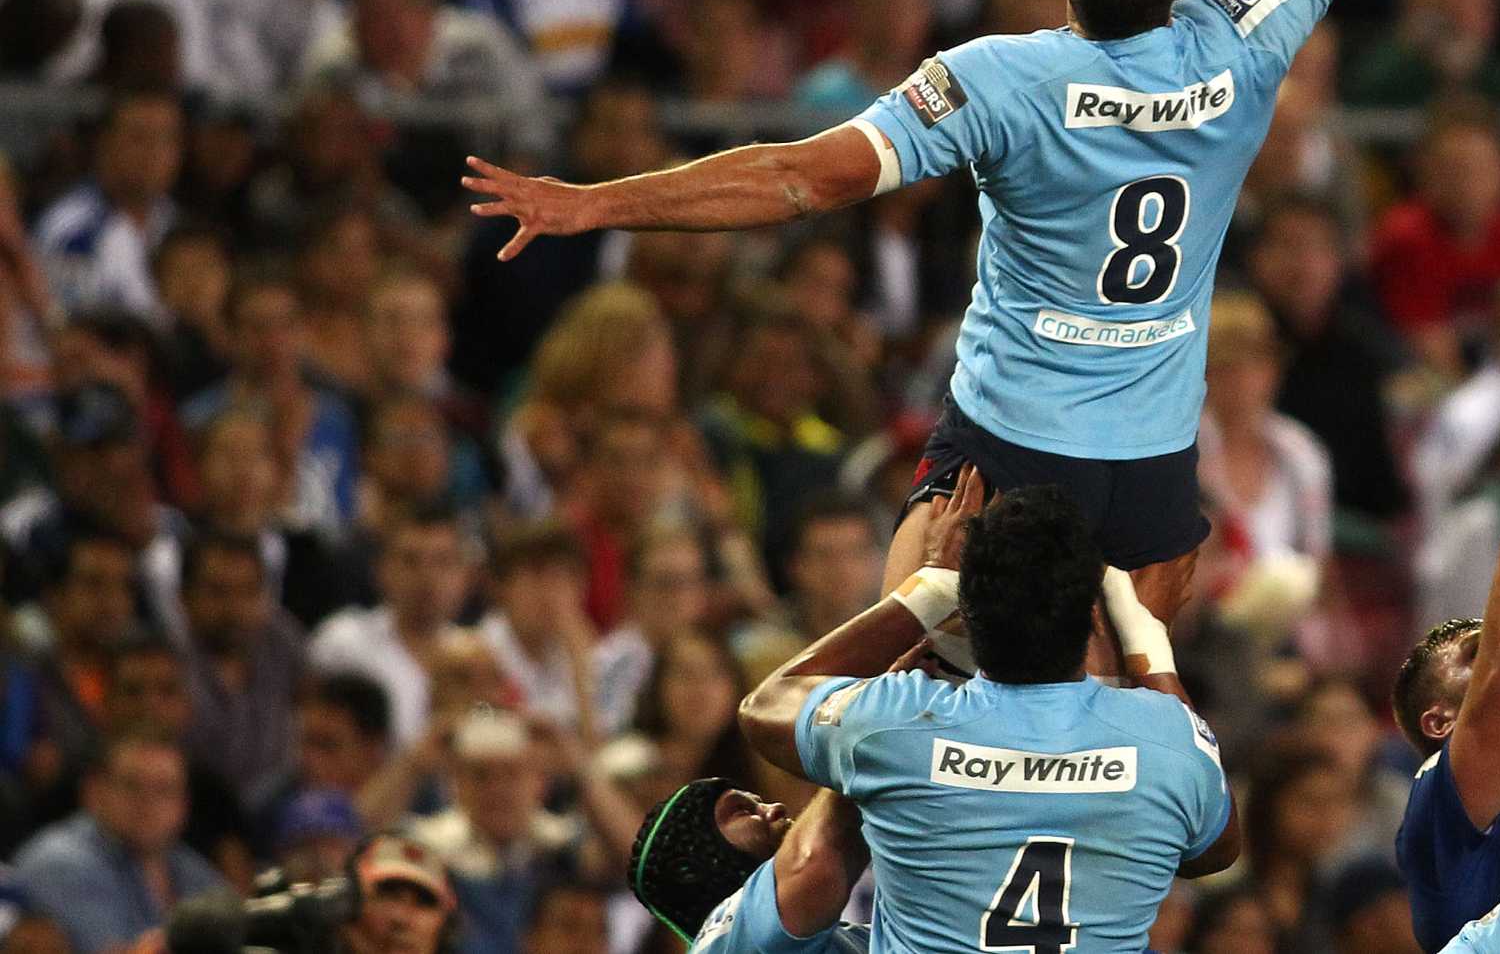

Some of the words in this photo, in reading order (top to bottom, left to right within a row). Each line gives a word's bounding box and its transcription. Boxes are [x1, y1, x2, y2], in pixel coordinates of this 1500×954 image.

[1075, 91, 1145, 124] Ray
[1096, 174, 1191, 306] 8
[938, 745, 1016, 785] Ray
[1023, 754, 1126, 783] White
[979, 835, 1081, 954] 4
